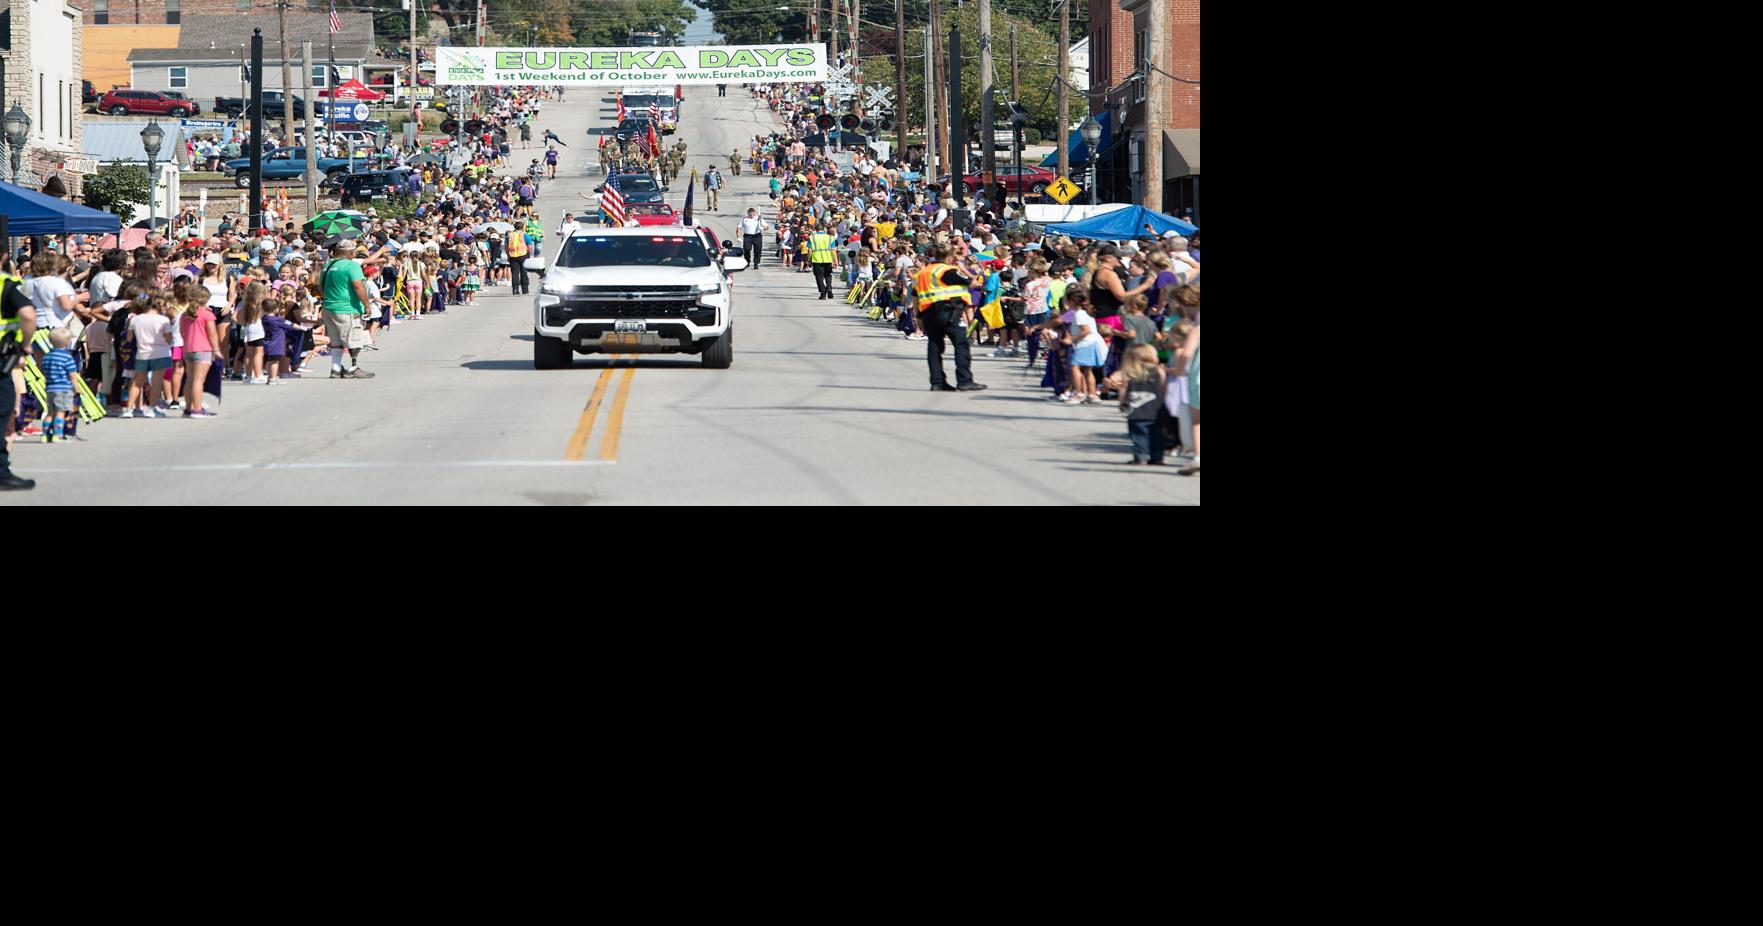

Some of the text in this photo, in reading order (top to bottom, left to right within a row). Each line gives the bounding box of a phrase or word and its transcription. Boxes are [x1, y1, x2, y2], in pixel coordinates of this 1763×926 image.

[496, 48, 816, 70] EUREKA DAYS
[495, 69, 816, 80] 1st Weekend of October www.EurekaDays.com
